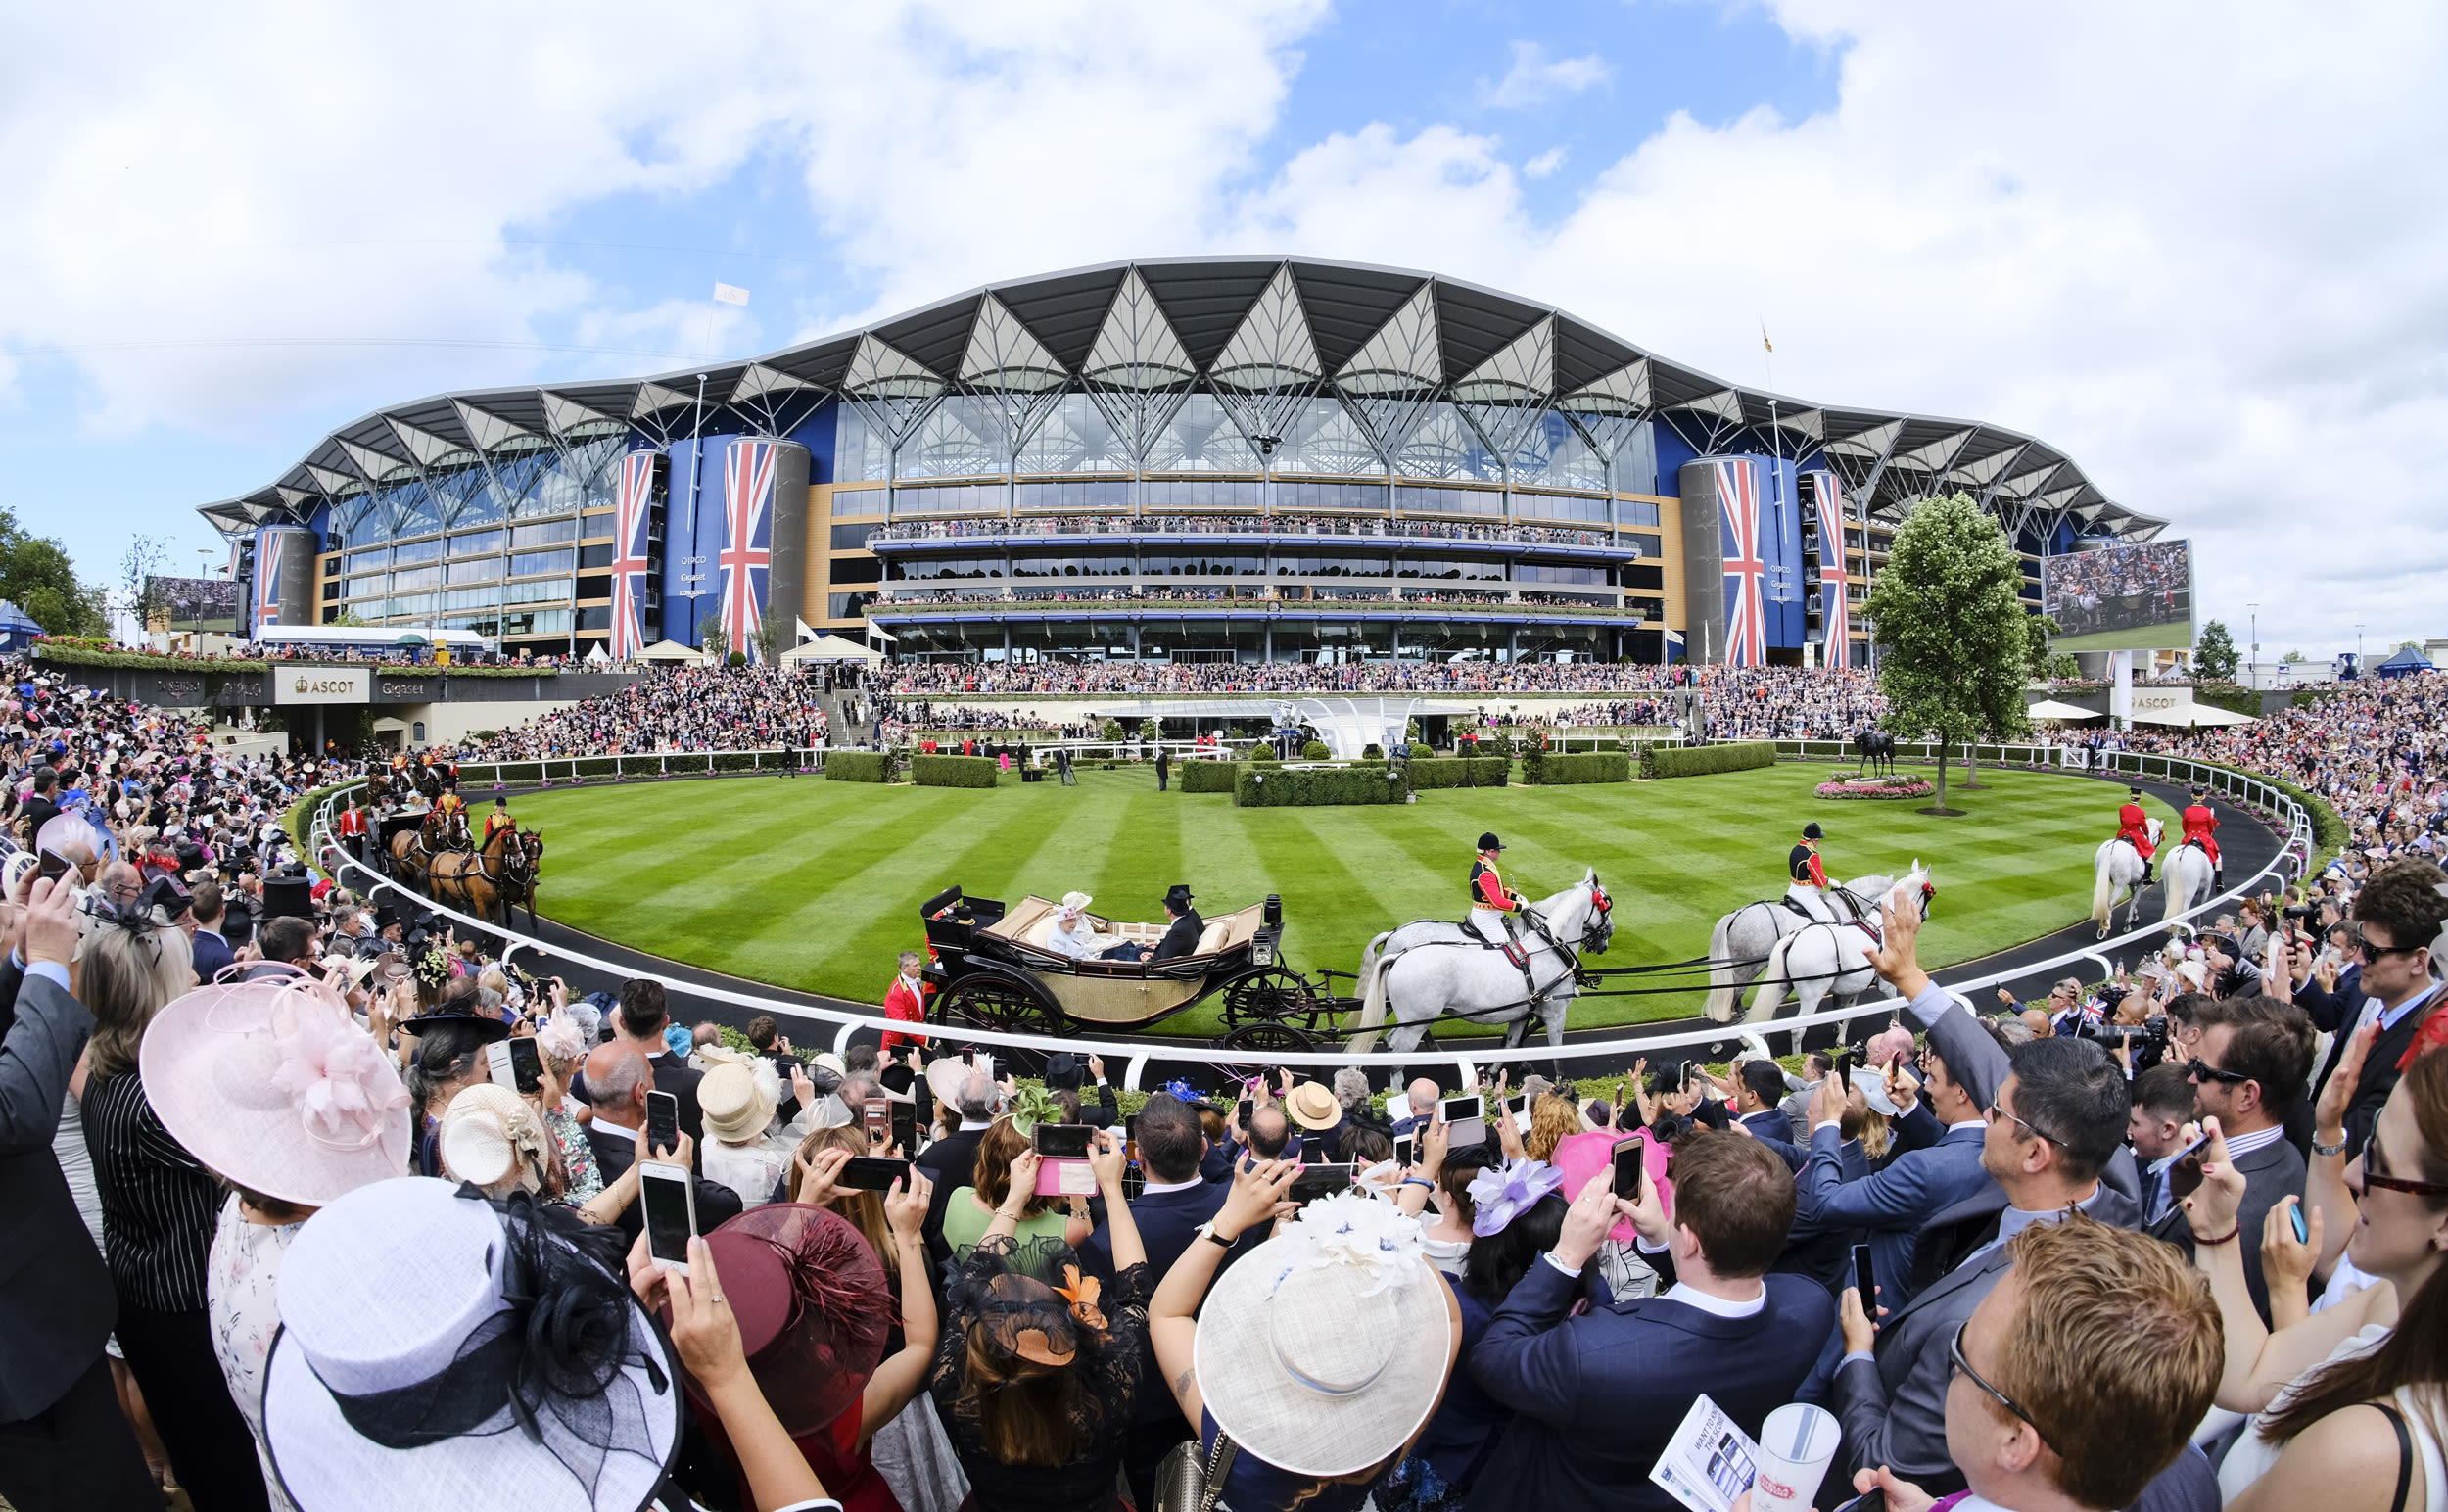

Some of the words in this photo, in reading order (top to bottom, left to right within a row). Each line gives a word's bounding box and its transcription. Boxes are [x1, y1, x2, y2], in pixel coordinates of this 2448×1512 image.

[310, 681, 354, 693] ASCOT
[382, 682, 424, 698] Gigaset
[2138, 698, 2176, 709] ASCOT
[1694, 1427, 1709, 1450] WANT
[1706, 1418, 1715, 1430] TO
[1704, 1435, 1716, 1451] THE
